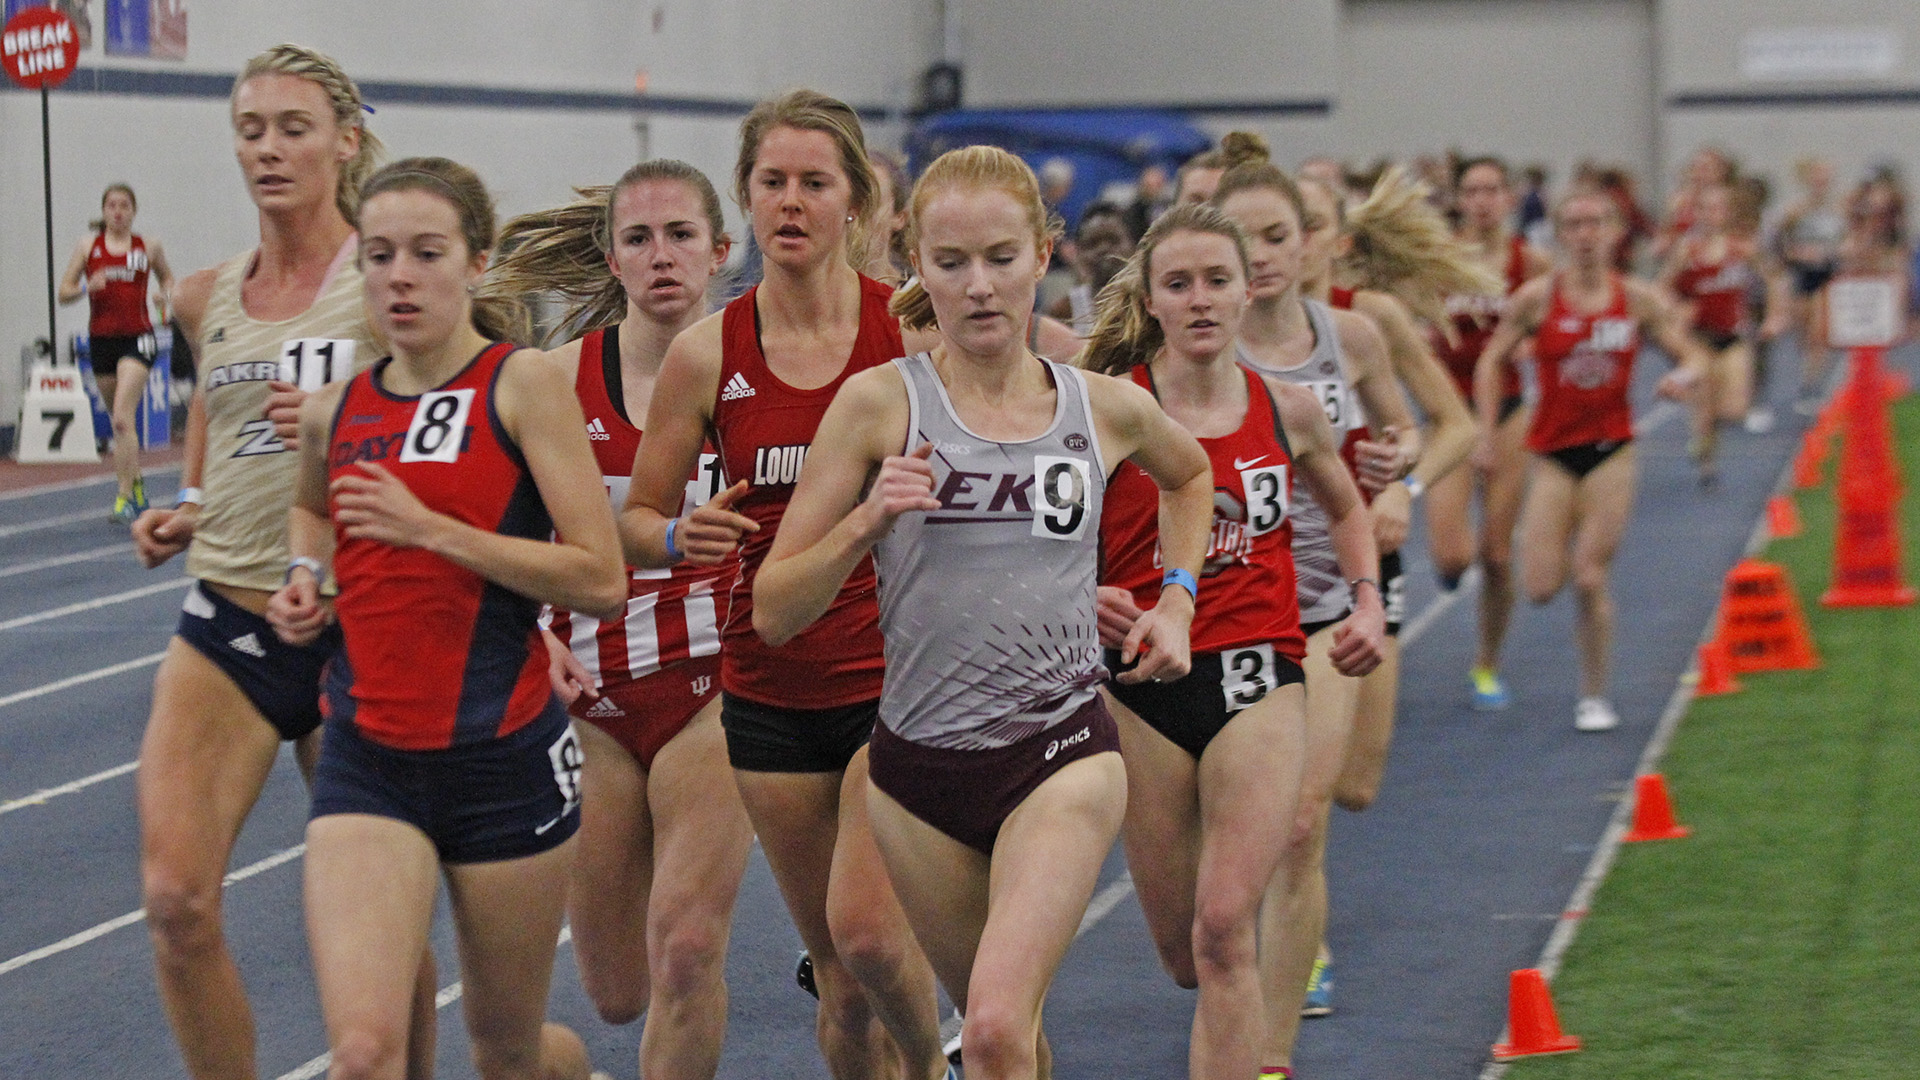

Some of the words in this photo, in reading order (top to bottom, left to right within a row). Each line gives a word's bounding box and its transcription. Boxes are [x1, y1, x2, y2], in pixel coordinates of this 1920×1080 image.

[3, 20, 72, 56] BREAK
[18, 47, 65, 77] LINE
[207, 361, 281, 391] AKR
[287, 341, 333, 386] 11
[722, 387, 757, 401] adidas
[41, 411, 75, 451] 7
[415, 395, 459, 455] 8
[754, 445, 812, 485] LOUI
[1044, 462, 1085, 535] 9
[1252, 472, 1281, 532] 3
[1232, 650, 1267, 704] 3
[586, 709, 626, 718] adidas
